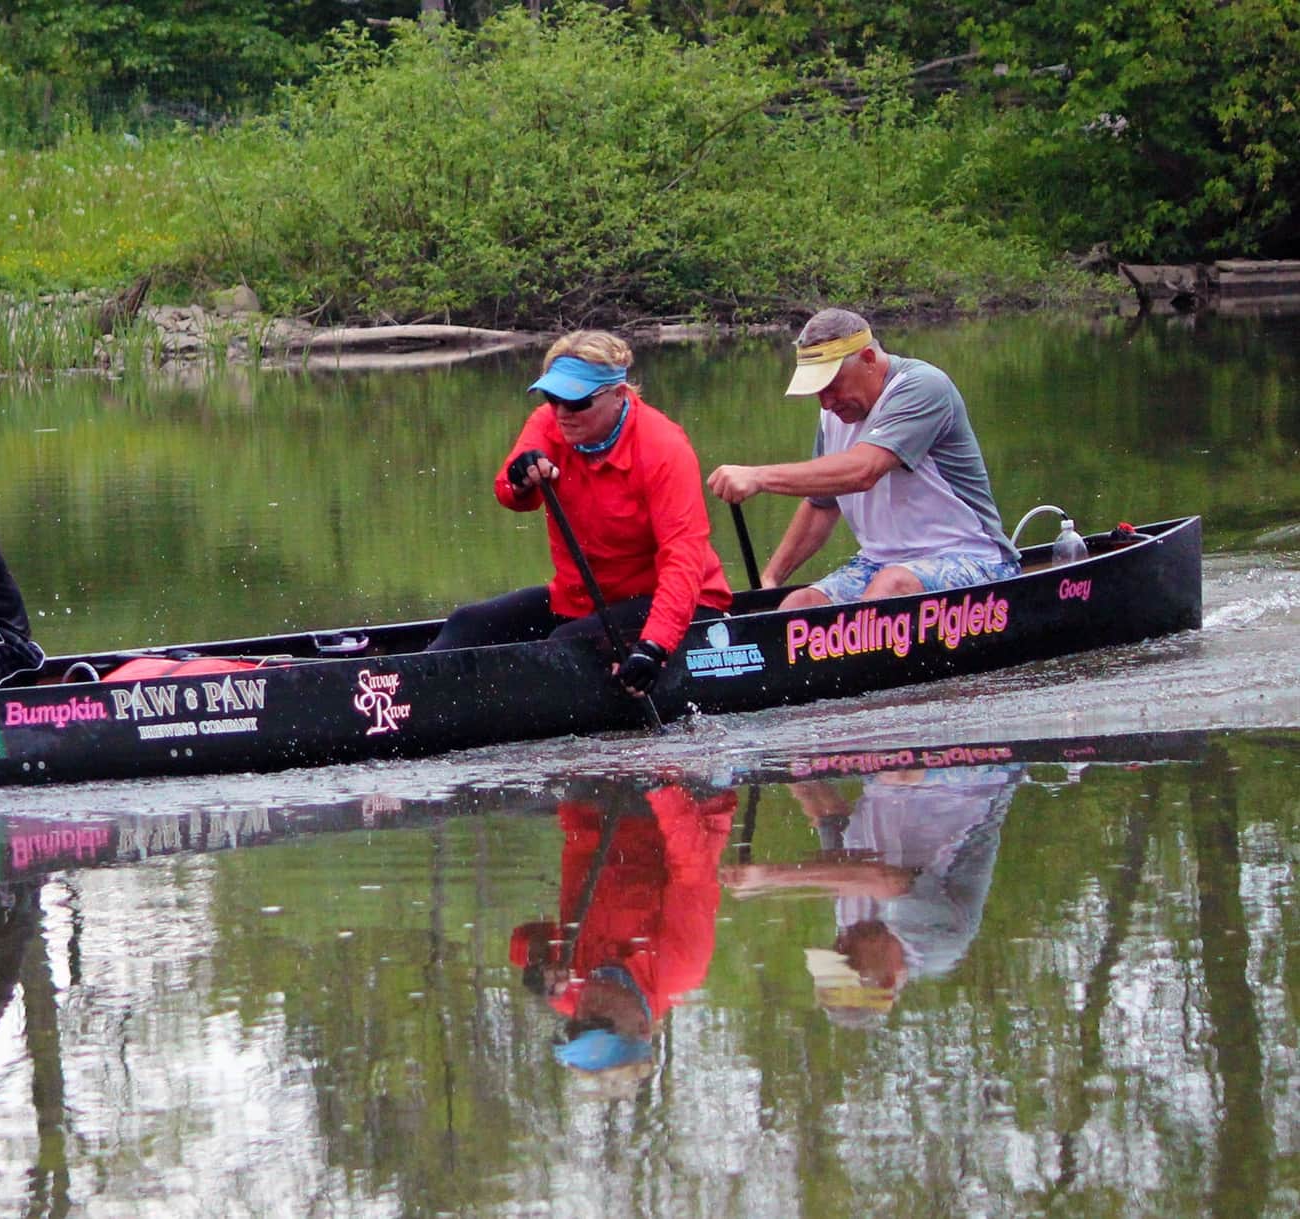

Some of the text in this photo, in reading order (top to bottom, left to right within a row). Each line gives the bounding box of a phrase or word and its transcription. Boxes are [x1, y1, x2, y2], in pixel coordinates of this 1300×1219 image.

[1059, 578, 1091, 601] Goey
[787, 592, 1009, 664] Paddling Piglets
[4, 696, 107, 728] Bumpkin
[111, 681, 178, 720] PAW
[202, 675, 267, 713] PAW
[137, 717, 258, 740] BREWING COMPANY
